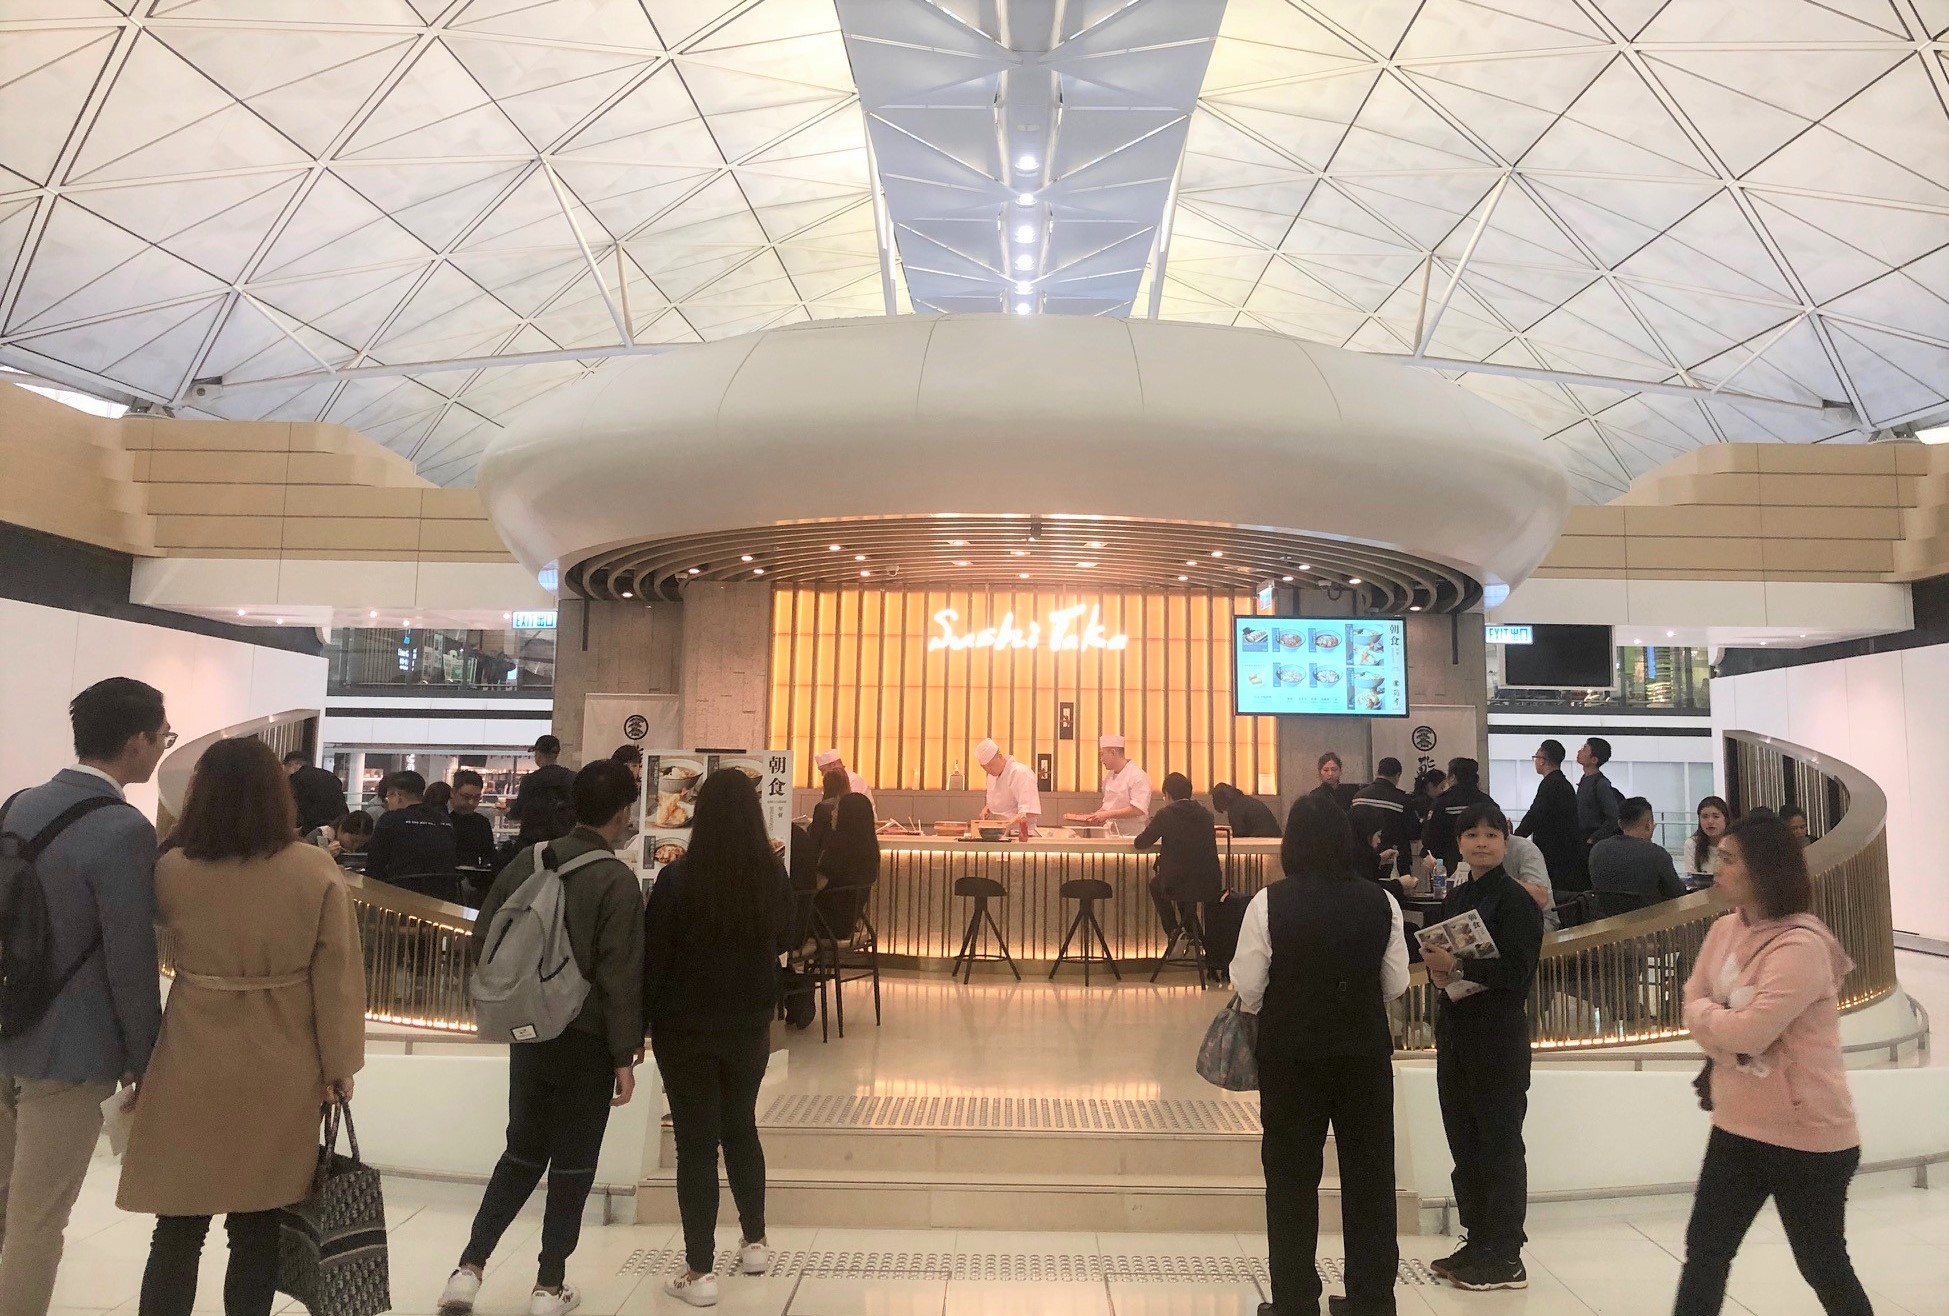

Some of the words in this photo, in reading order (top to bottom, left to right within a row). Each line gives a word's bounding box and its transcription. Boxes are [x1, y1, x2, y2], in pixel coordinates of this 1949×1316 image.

[516, 613, 534, 627] EXIT
[537, 613, 554, 627] 出口
[927, 608, 1041, 652] Sushi
[1048, 603, 1129, 652] Taka
[1389, 624, 1400, 646] 朝食
[1489, 627, 1509, 641] EXIT
[1511, 627, 1528, 641] 出口
[768, 755, 787, 796] 朝食
